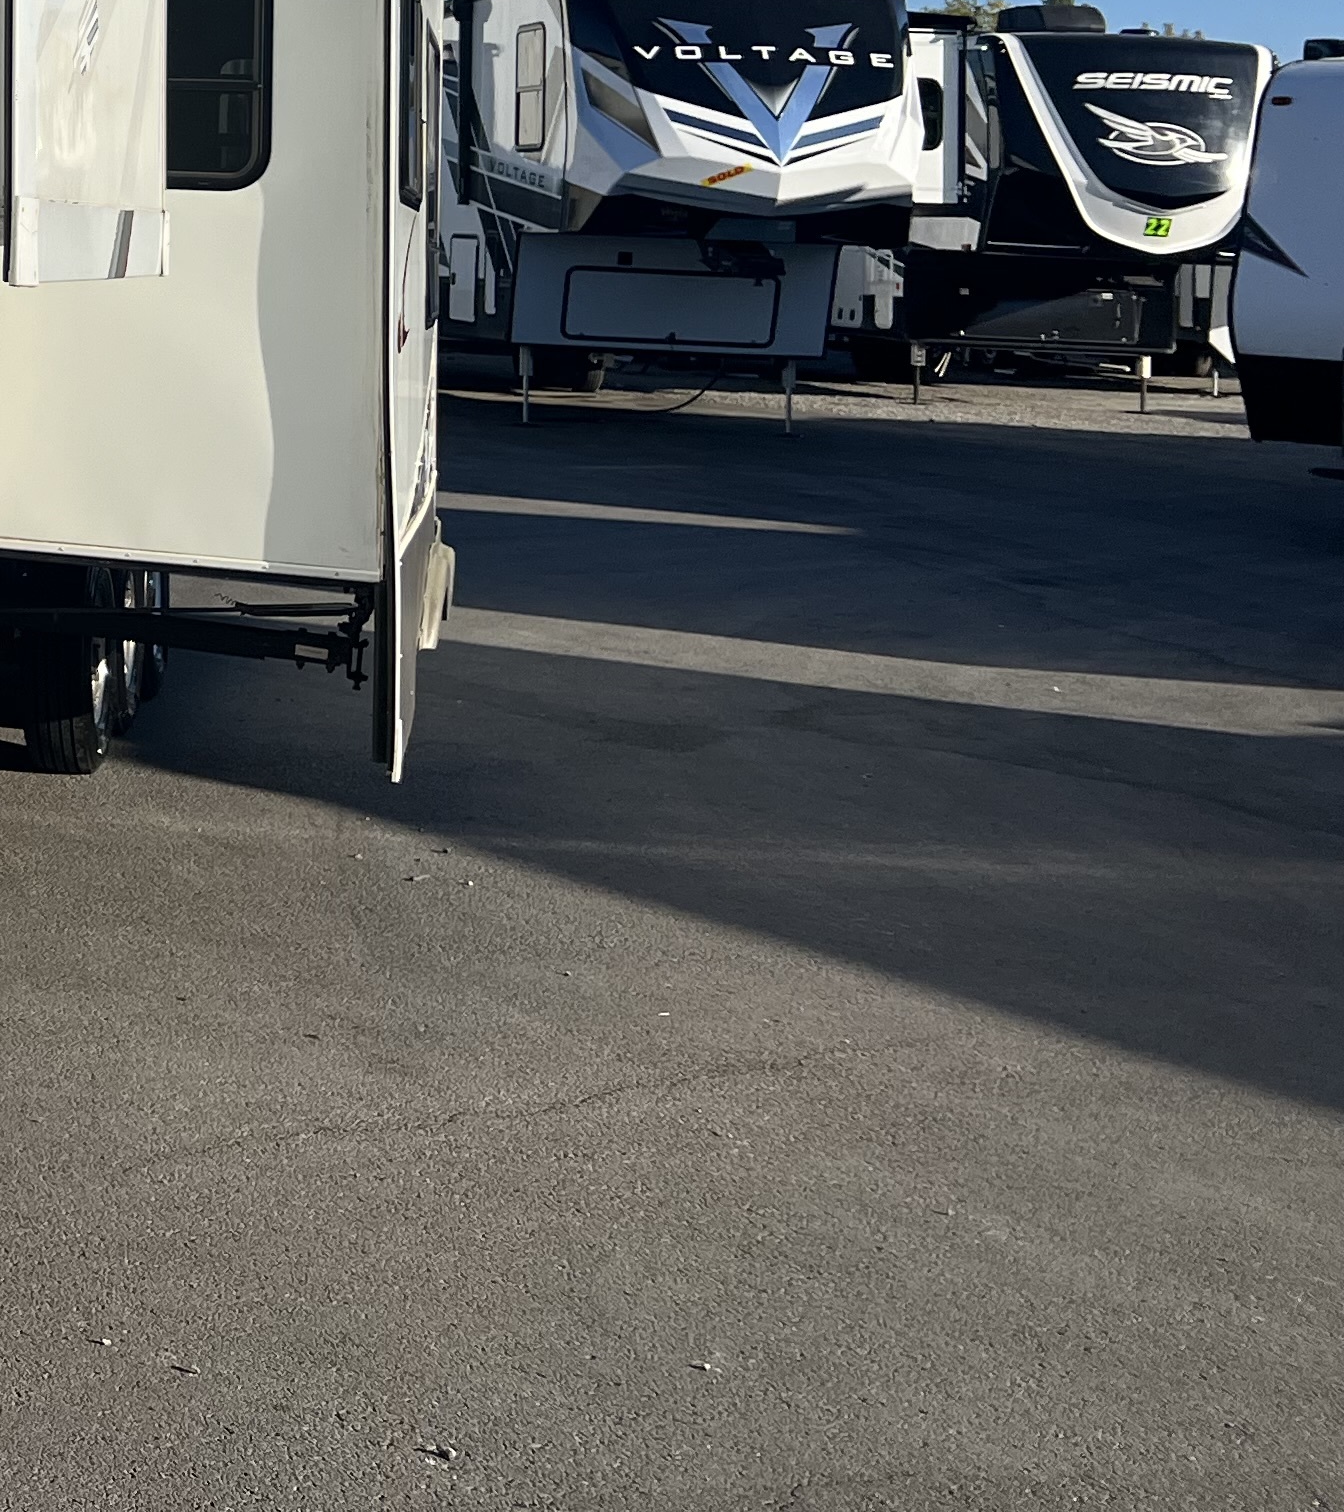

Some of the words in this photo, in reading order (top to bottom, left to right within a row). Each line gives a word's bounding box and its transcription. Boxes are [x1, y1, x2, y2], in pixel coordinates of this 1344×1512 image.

[633, 45, 894, 68] VOLTAGE
[1073, 72, 1233, 96] SEISMIC
[490, 157, 545, 188] VOLTAGE
[707, 165, 745, 185] SOLD
[1145, 219, 1171, 236] 22
